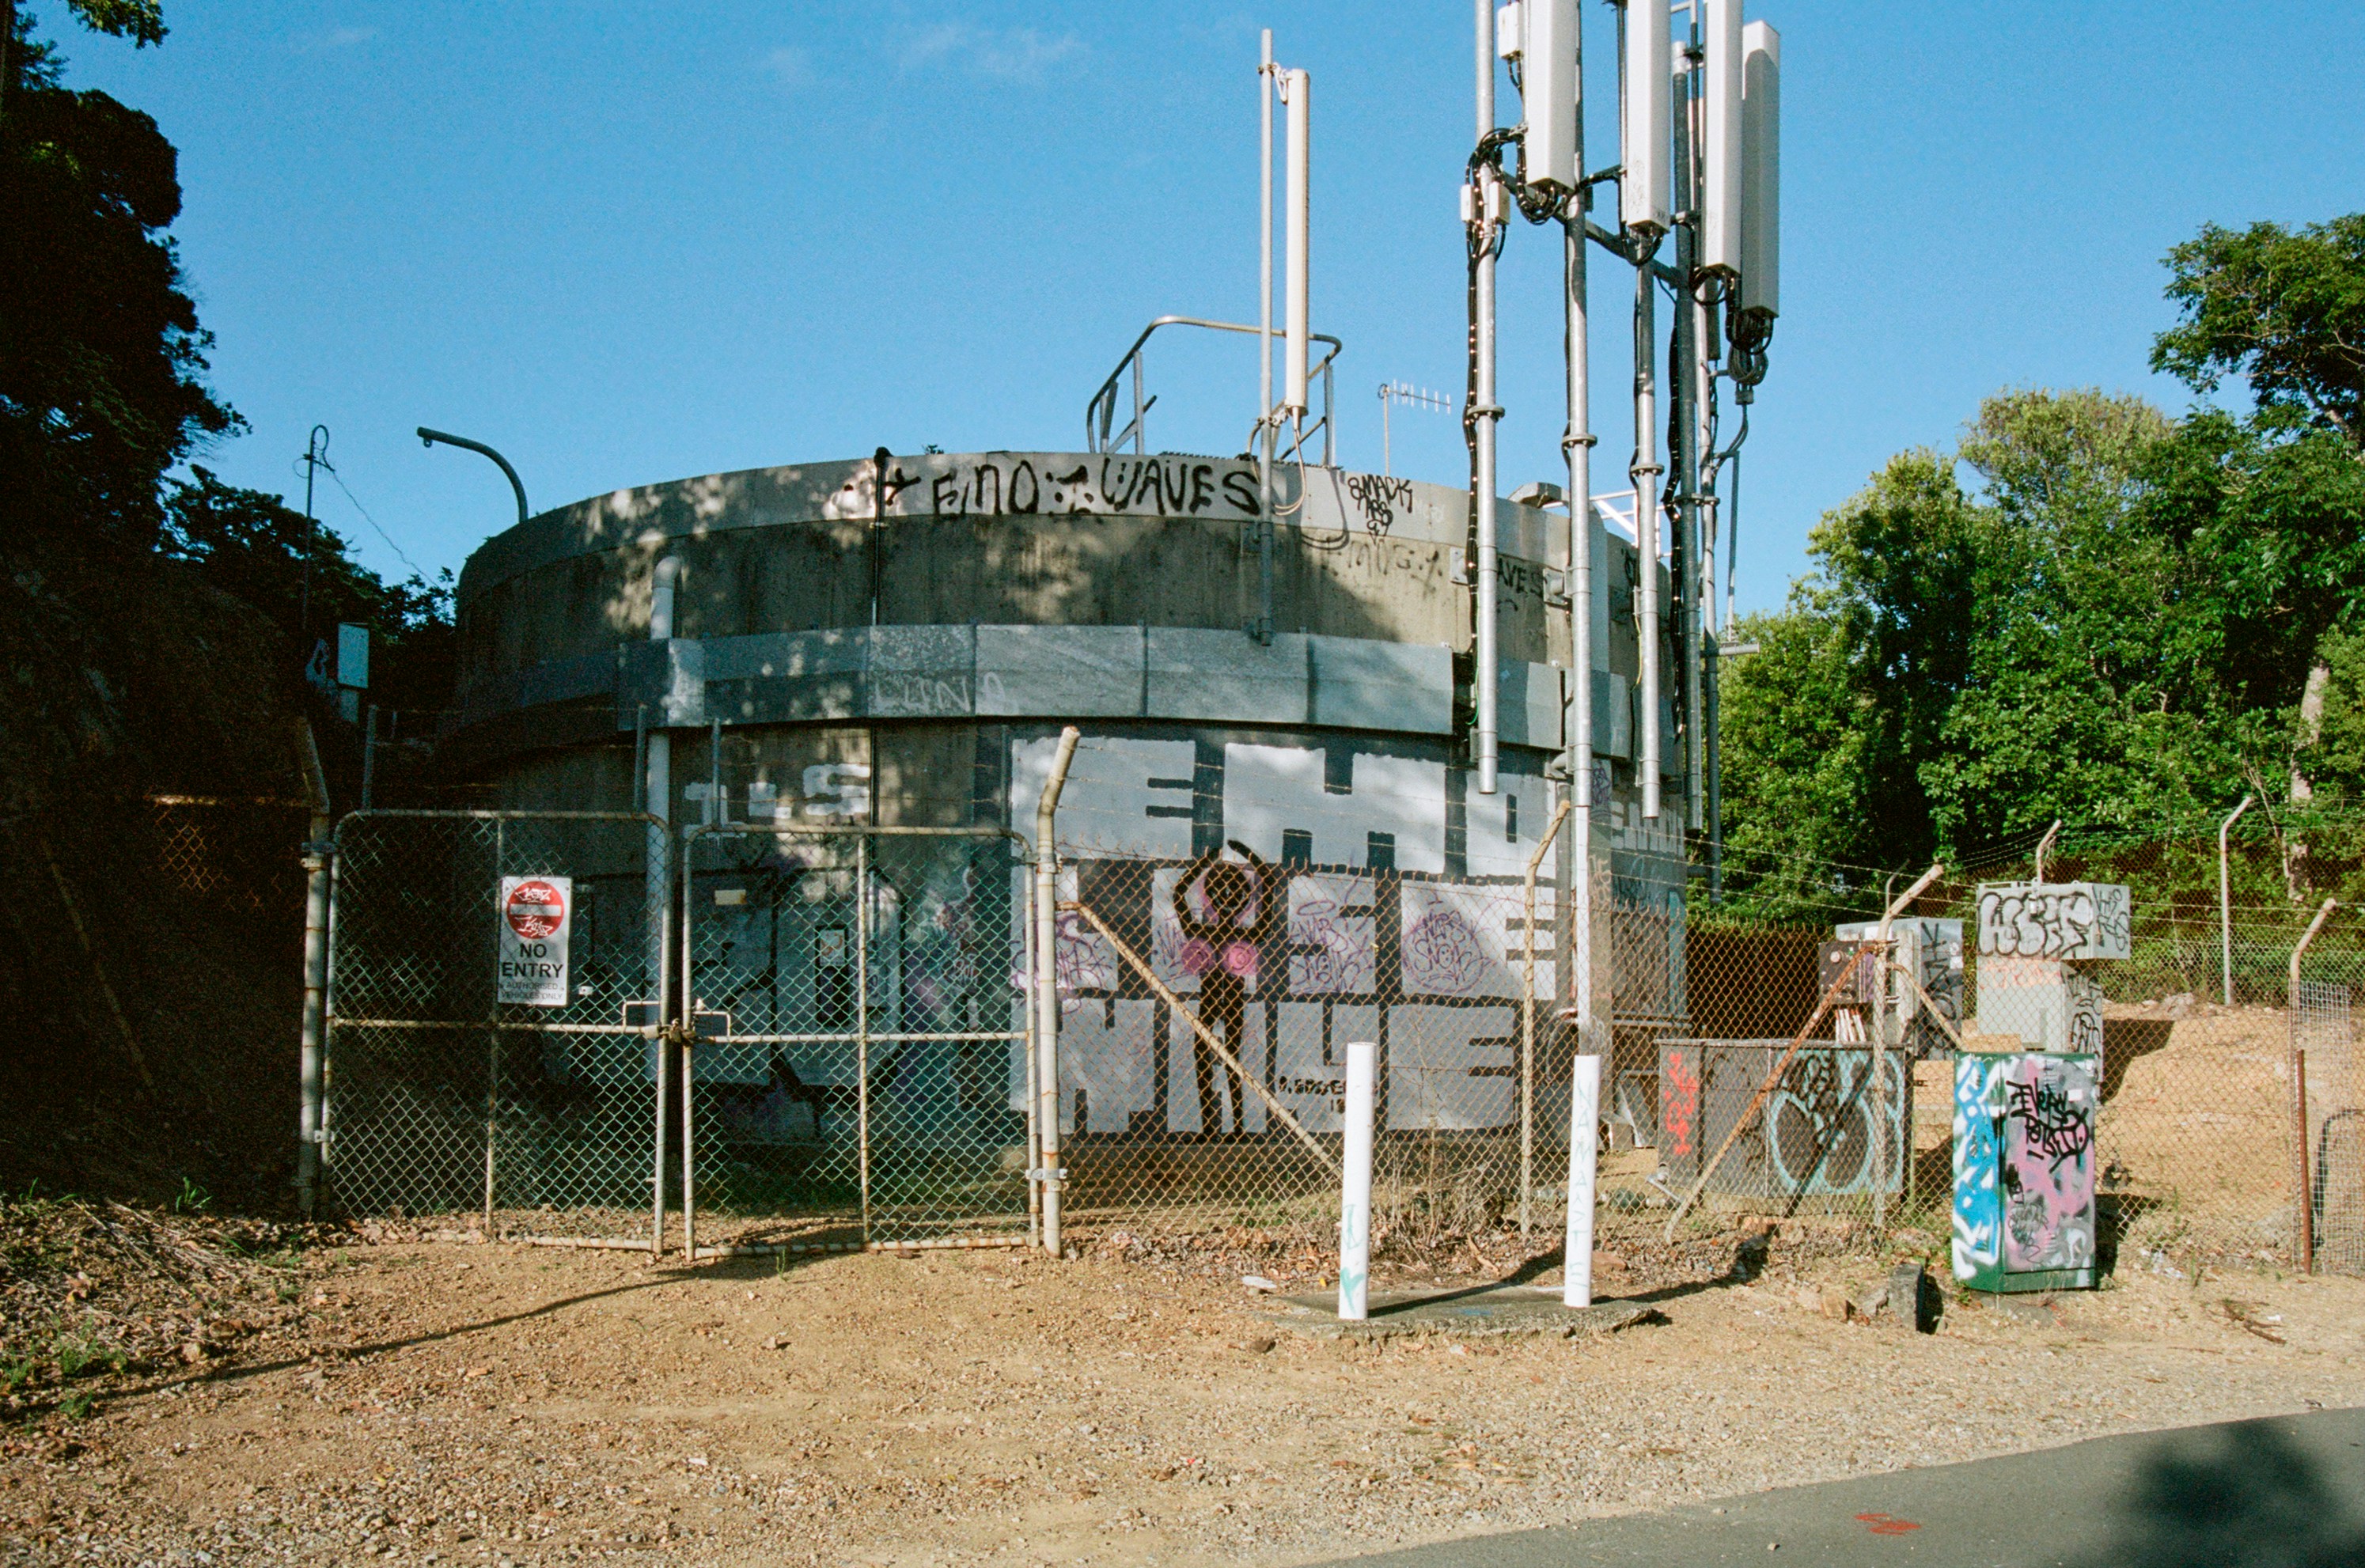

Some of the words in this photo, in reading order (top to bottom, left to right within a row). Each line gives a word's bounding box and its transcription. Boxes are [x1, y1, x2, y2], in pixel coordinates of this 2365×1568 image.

[1100, 456, 1261, 516] WAVES
[519, 943, 547, 959] NO
[502, 961, 564, 979] ENTRY
[506, 981, 559, 991] AUTHORISED
[501, 990, 541, 1000] VEHICLES
[542, 991, 563, 1001] ONLY
